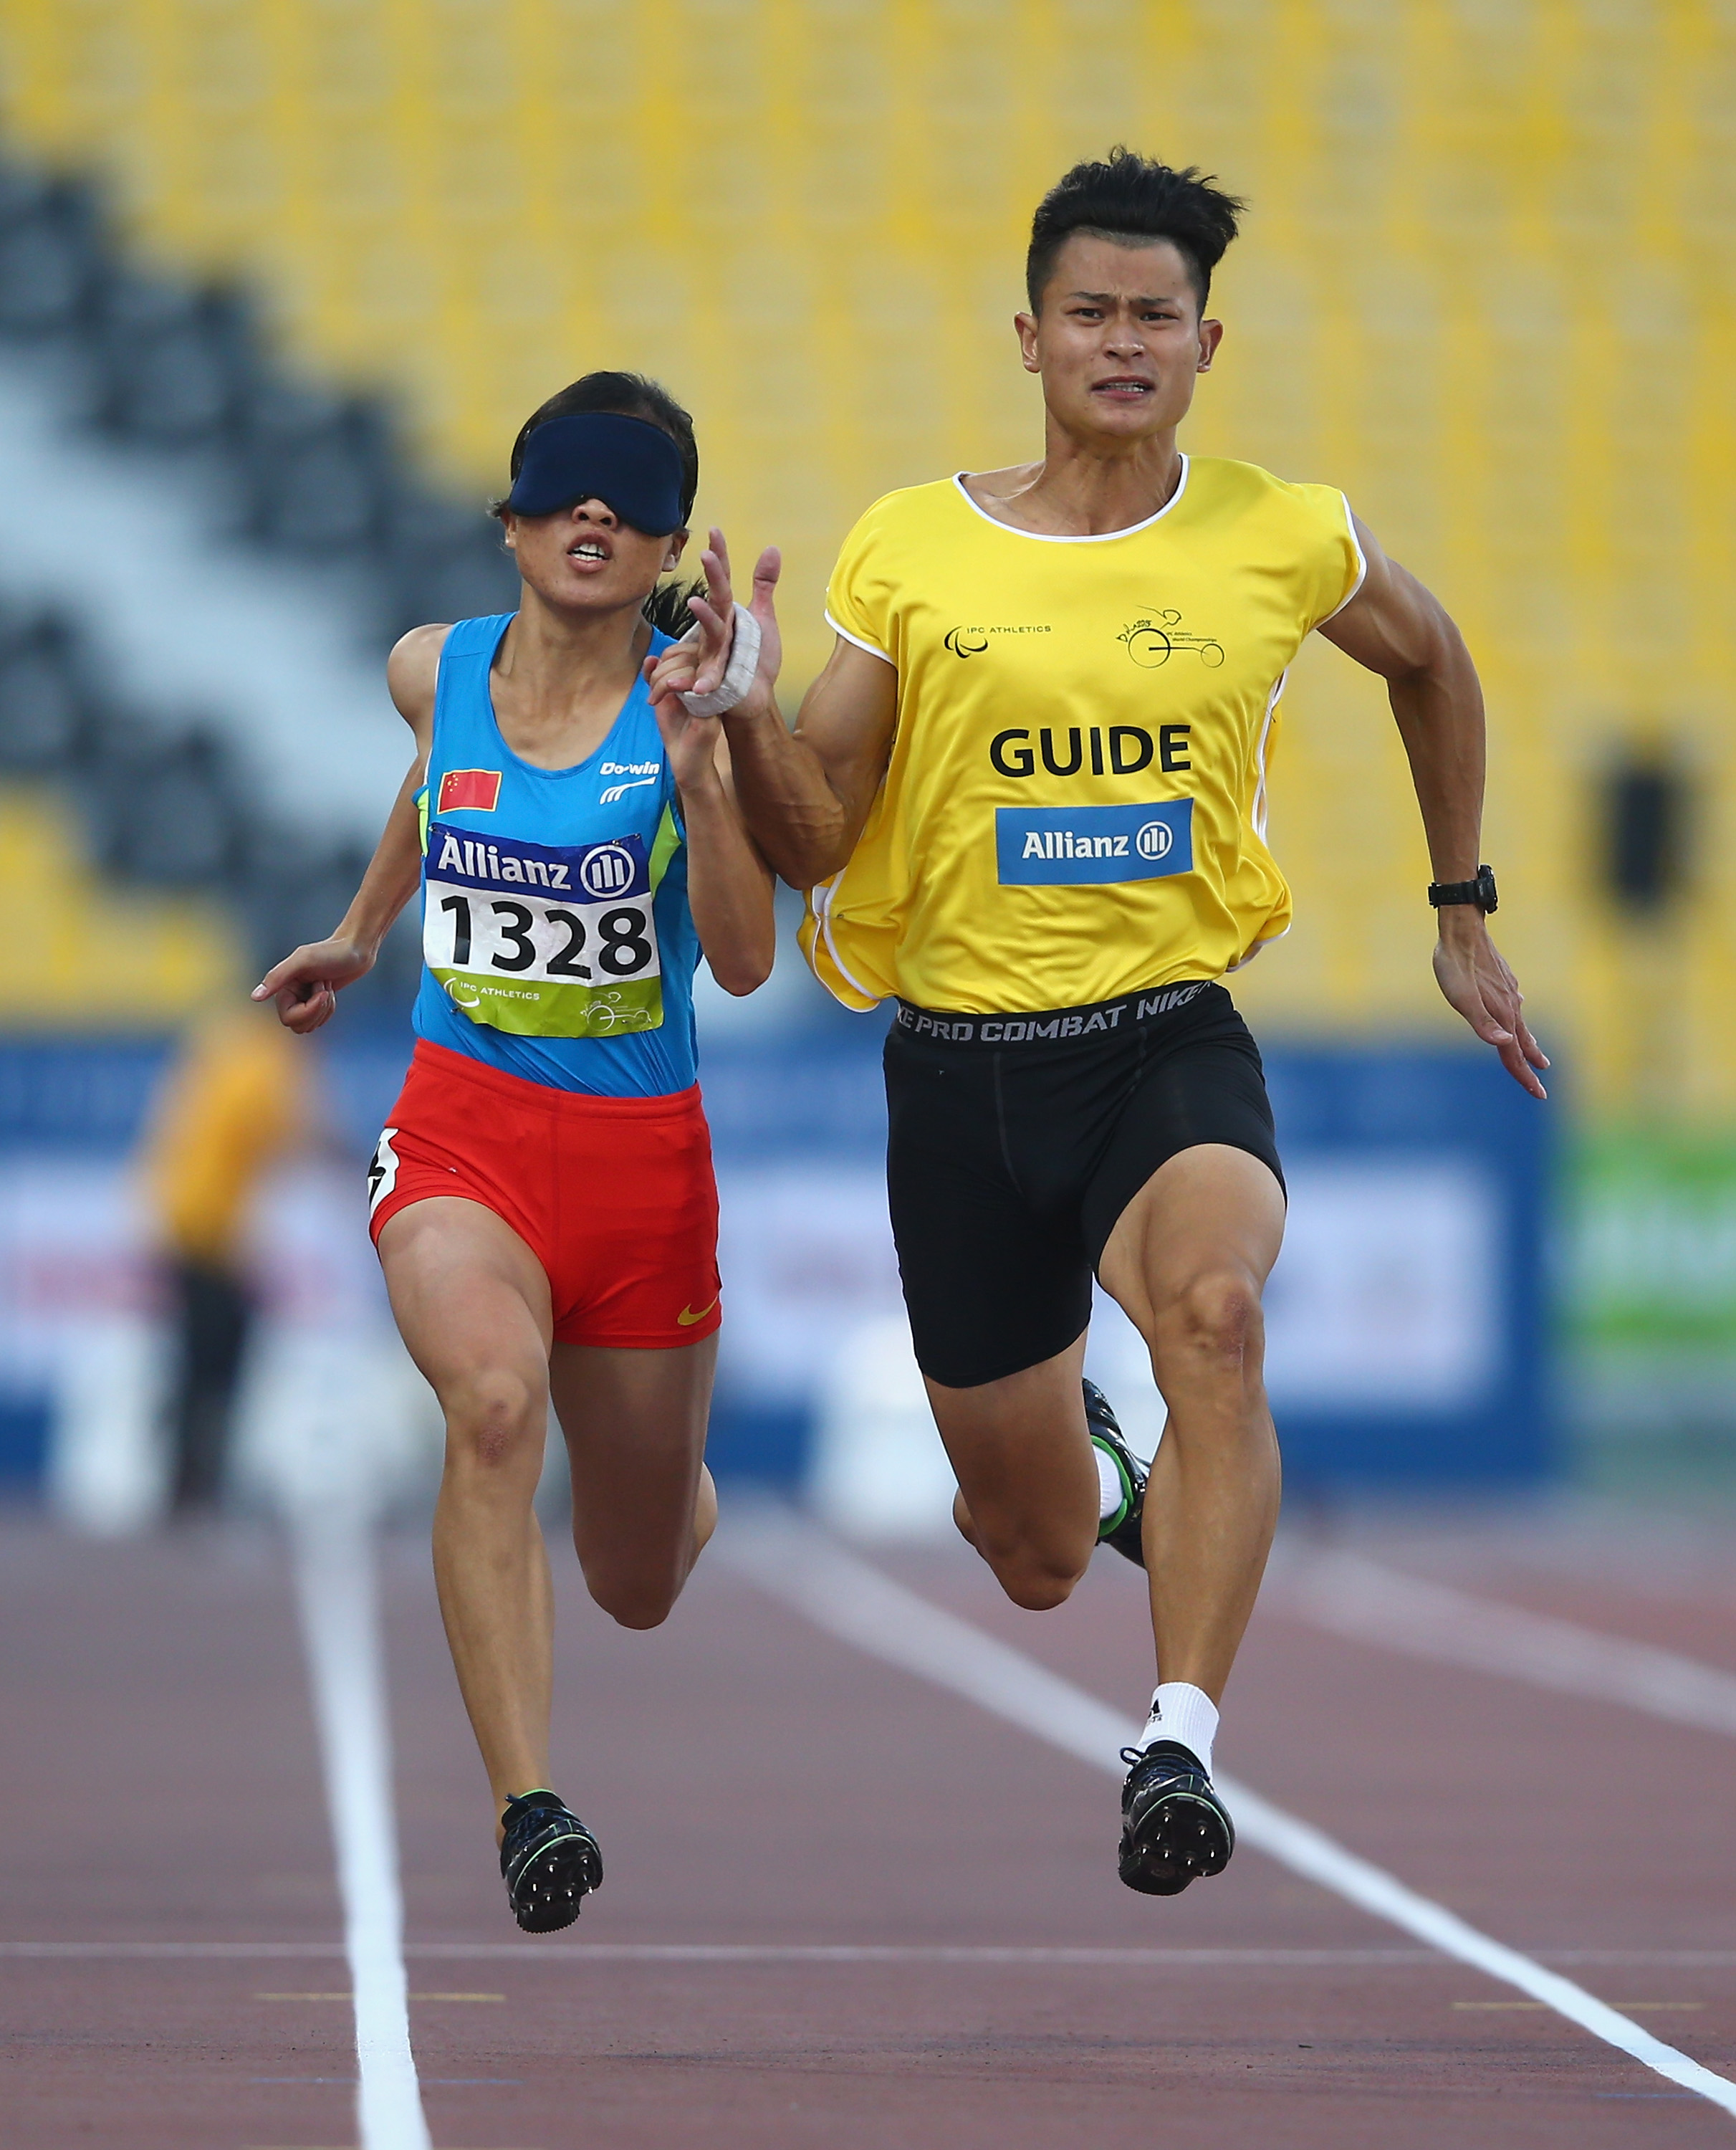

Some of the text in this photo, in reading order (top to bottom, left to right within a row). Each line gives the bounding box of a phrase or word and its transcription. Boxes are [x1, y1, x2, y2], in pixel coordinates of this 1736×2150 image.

[989, 625, 1052, 634] ATHLETICS
[989, 724, 1192, 778] GUIDE
[438, 834, 572, 891] Allianz
[1021, 831, 1130, 859] Allianz
[441, 895, 653, 980] 1328
[460, 981, 541, 1000] IPC ATHLETICS
[915, 1015, 974, 1041] PRO
[979, 1004, 1128, 1042] COMBAT
[1136, 982, 1204, 1020] NIKE
